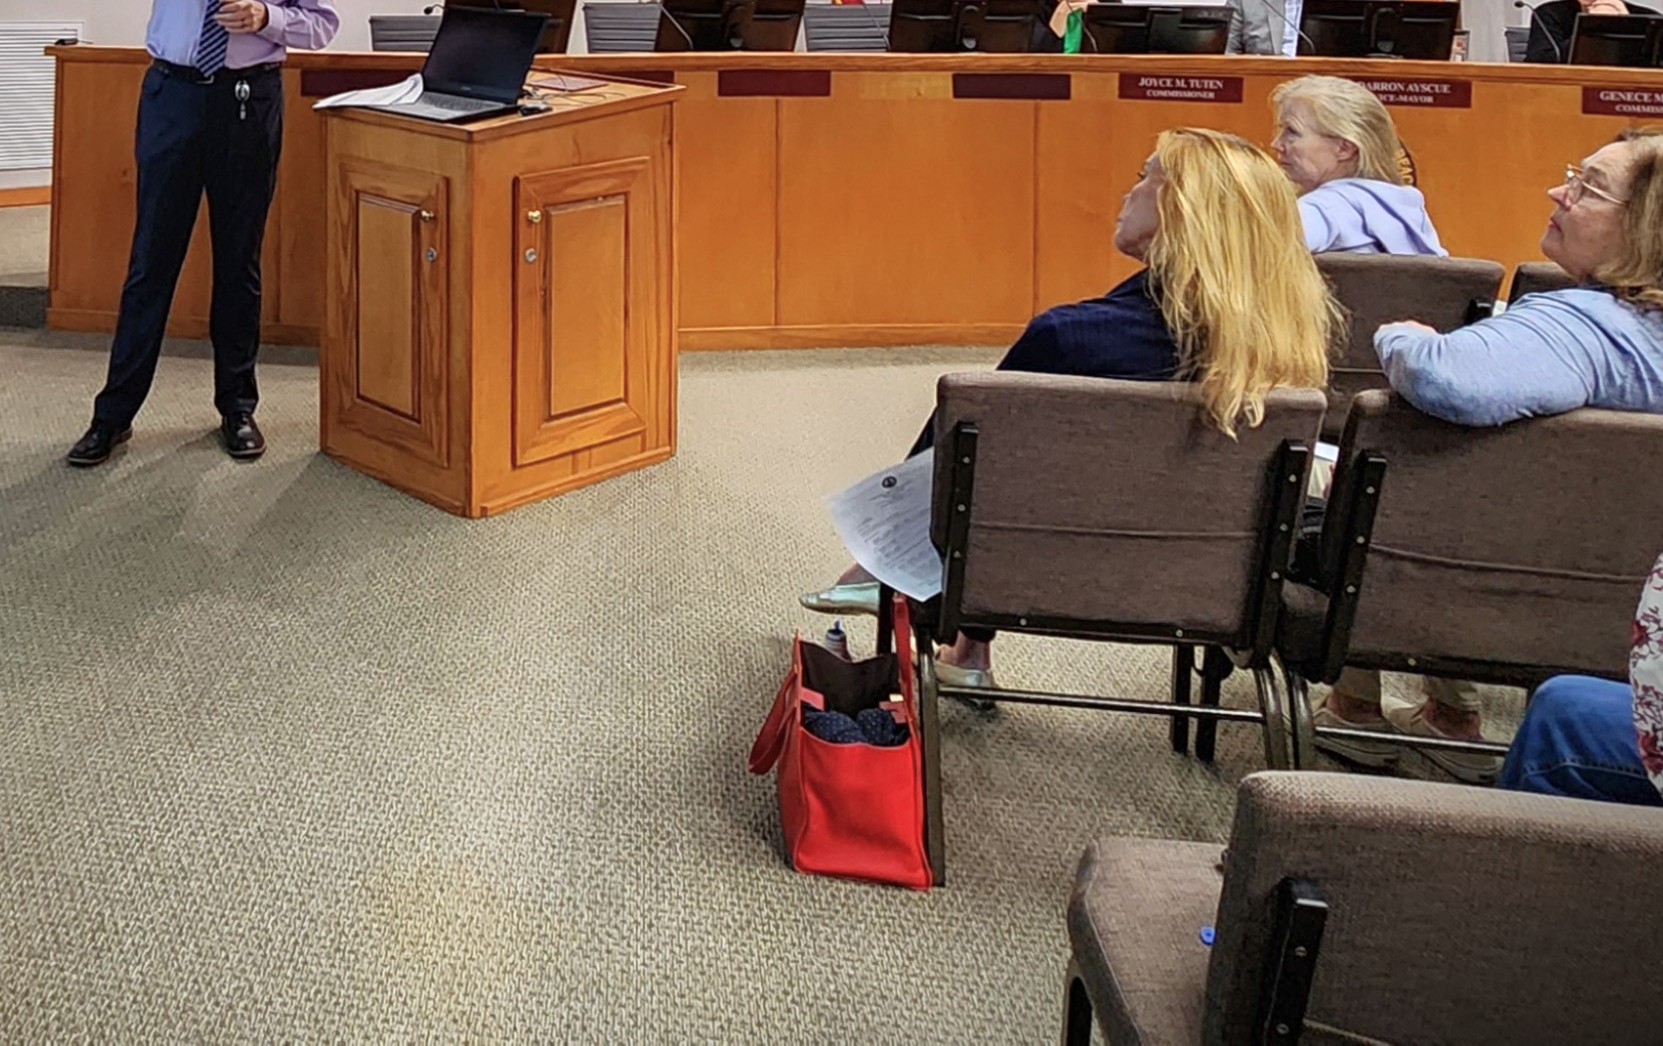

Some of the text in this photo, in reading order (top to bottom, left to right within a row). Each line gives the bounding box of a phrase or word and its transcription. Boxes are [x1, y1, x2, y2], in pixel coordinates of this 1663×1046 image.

[1138, 76, 1174, 88] JOYCE
[1189, 78, 1224, 89] TUTEN
[1146, 88, 1215, 99] COMMISSIONER
[1406, 83, 1451, 94] AYSCUE
[1379, 93, 1434, 104] ICE-MAYOR
[1599, 90, 1652, 103] GENECE
